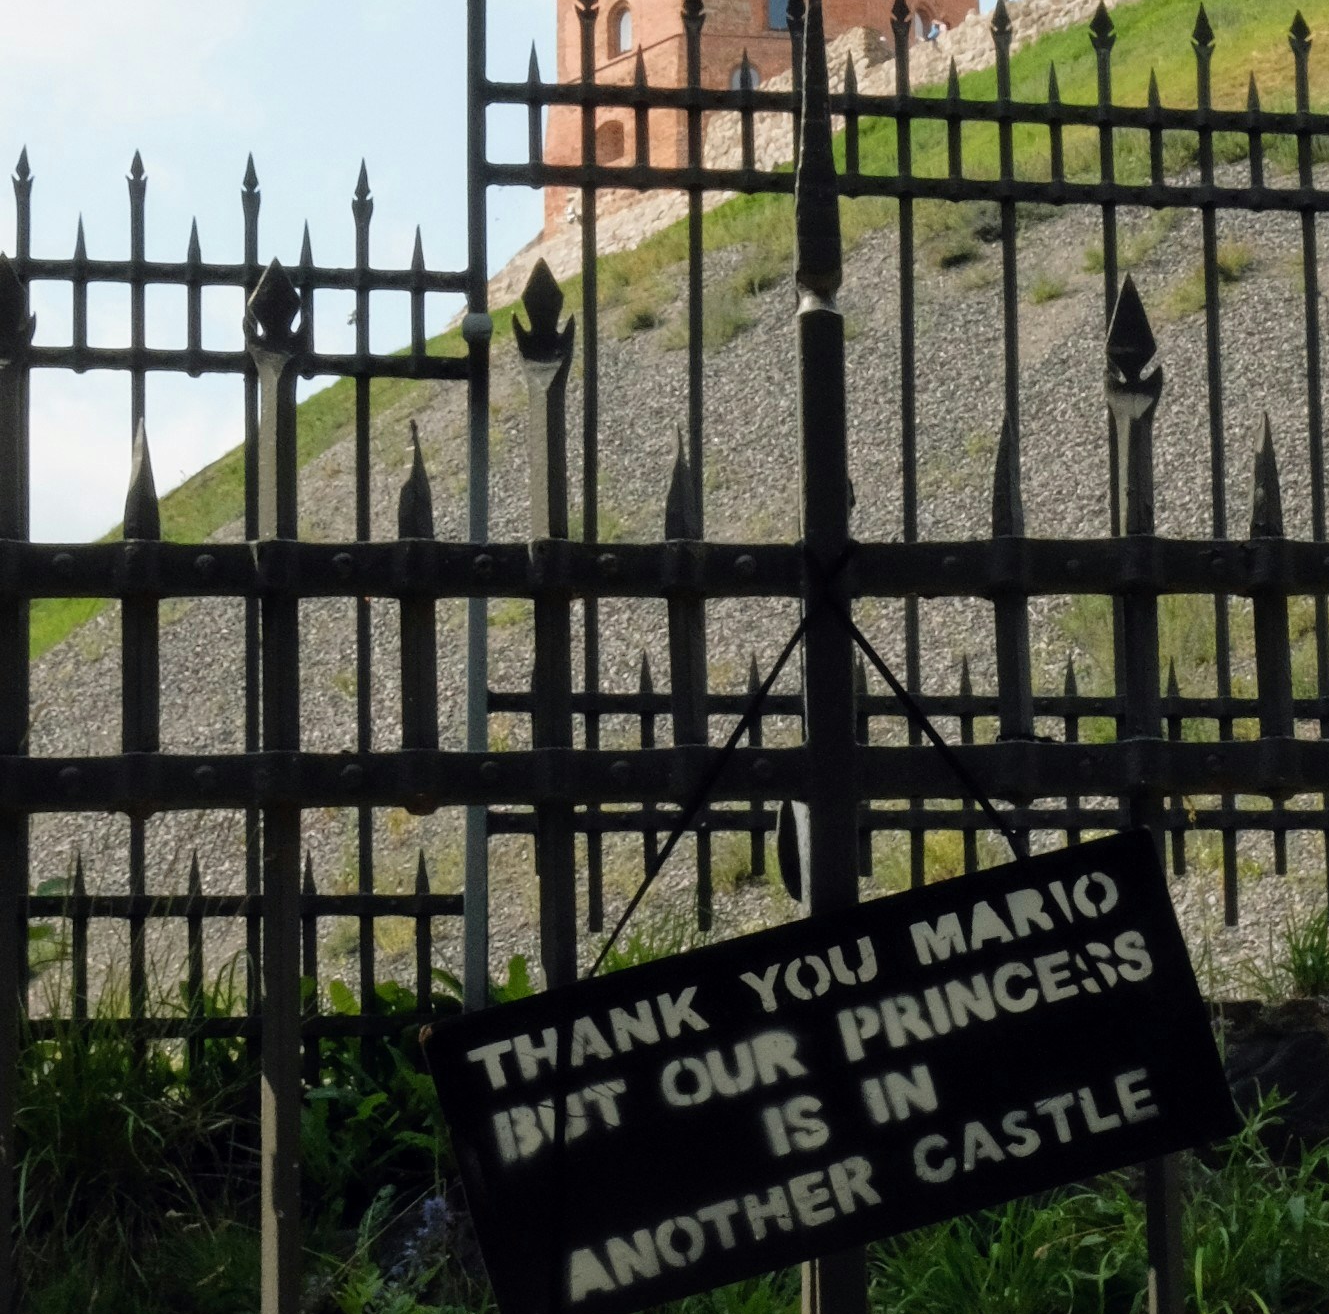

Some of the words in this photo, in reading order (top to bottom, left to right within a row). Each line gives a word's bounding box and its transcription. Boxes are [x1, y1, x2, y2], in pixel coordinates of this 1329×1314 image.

[467, 986, 710, 1089] THANK
[739, 935, 879, 1013] YOU
[909, 871, 1119, 966] MARIO
[490, 1078, 628, 1164] BUT
[660, 1030, 809, 1107] OUR
[836, 929, 1154, 1064] PRINCESS
[568, 1155, 883, 1303] ANOTHER
[912, 1067, 1160, 1183] CASTLE
[762, 1094, 831, 1158] IS
[861, 1063, 940, 1125] IN
